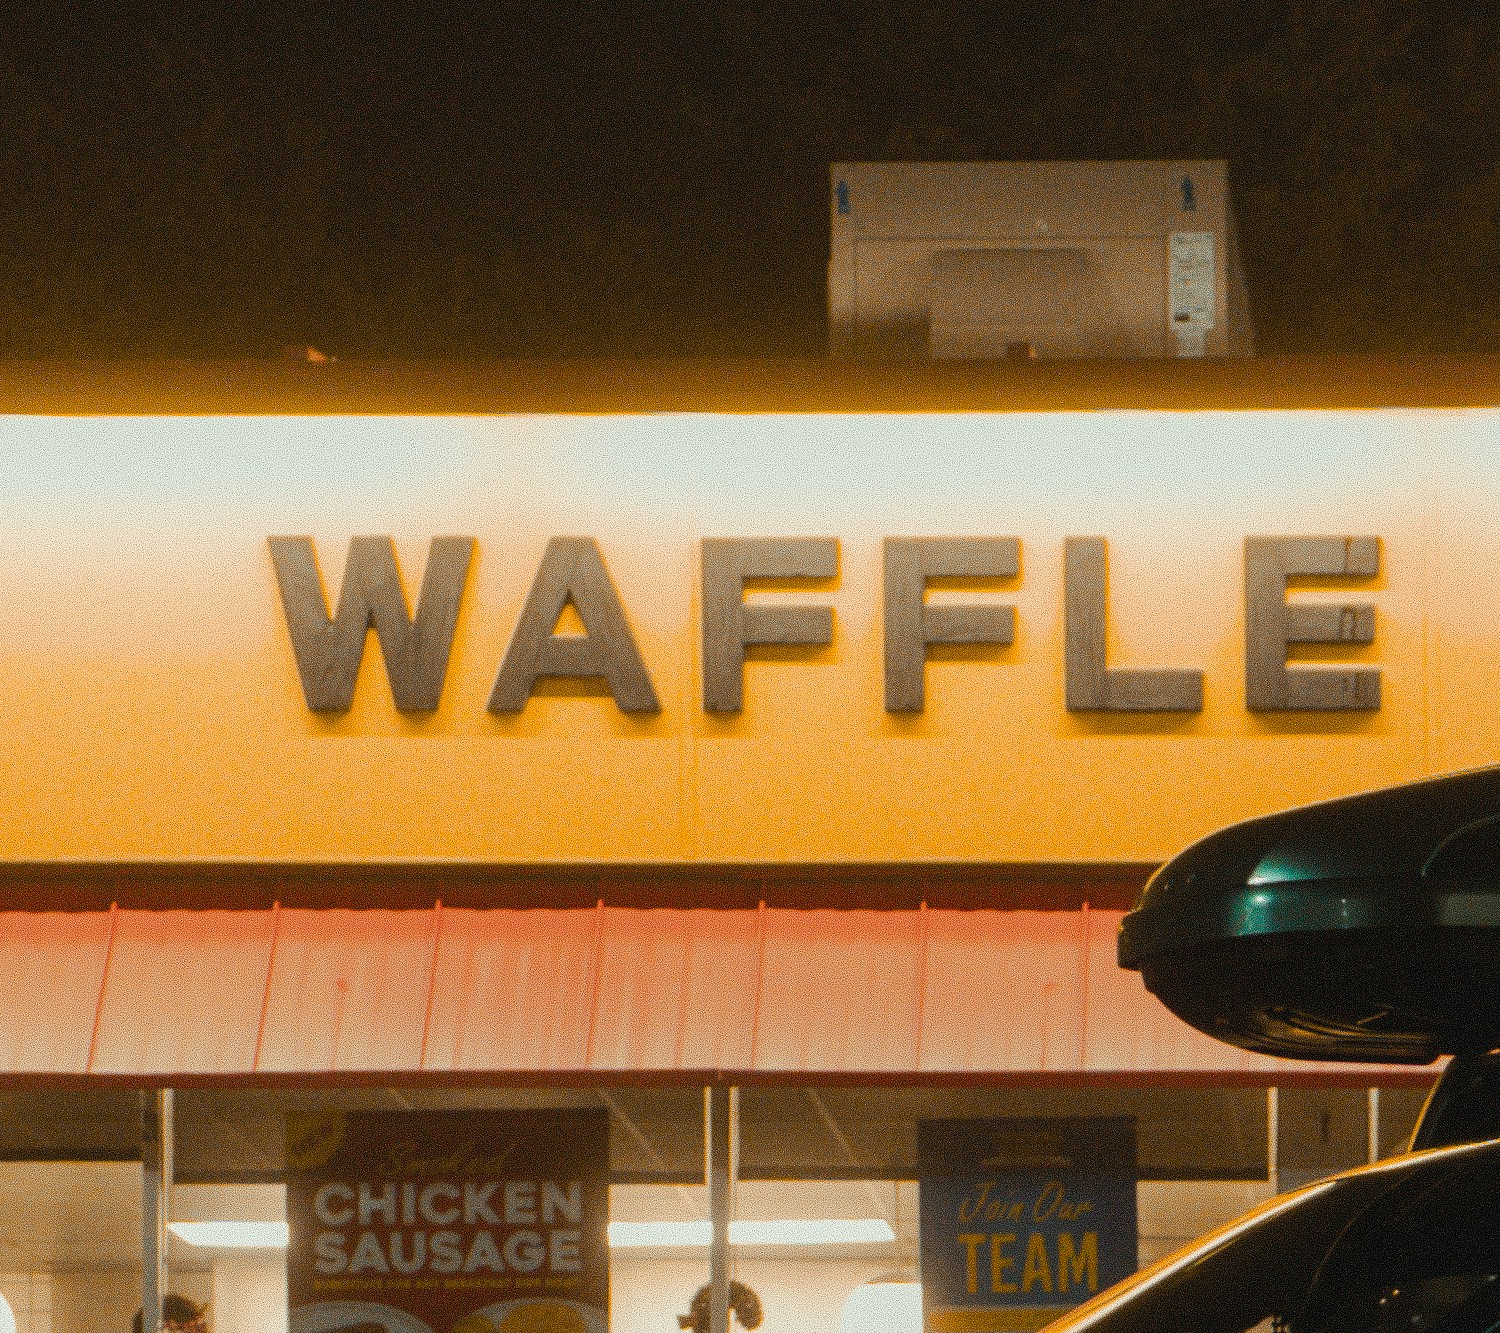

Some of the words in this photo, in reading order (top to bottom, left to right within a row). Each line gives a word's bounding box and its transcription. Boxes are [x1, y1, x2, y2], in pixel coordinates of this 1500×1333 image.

[267, 535, 1384, 717] WAFFLE
[314, 1181, 582, 1226] CHICKEN
[958, 1181, 1025, 1223] Join
[1033, 1180, 1095, 1223] Our
[314, 1230, 582, 1274] SAUSAGE
[957, 1231, 1099, 1295] TEAM
